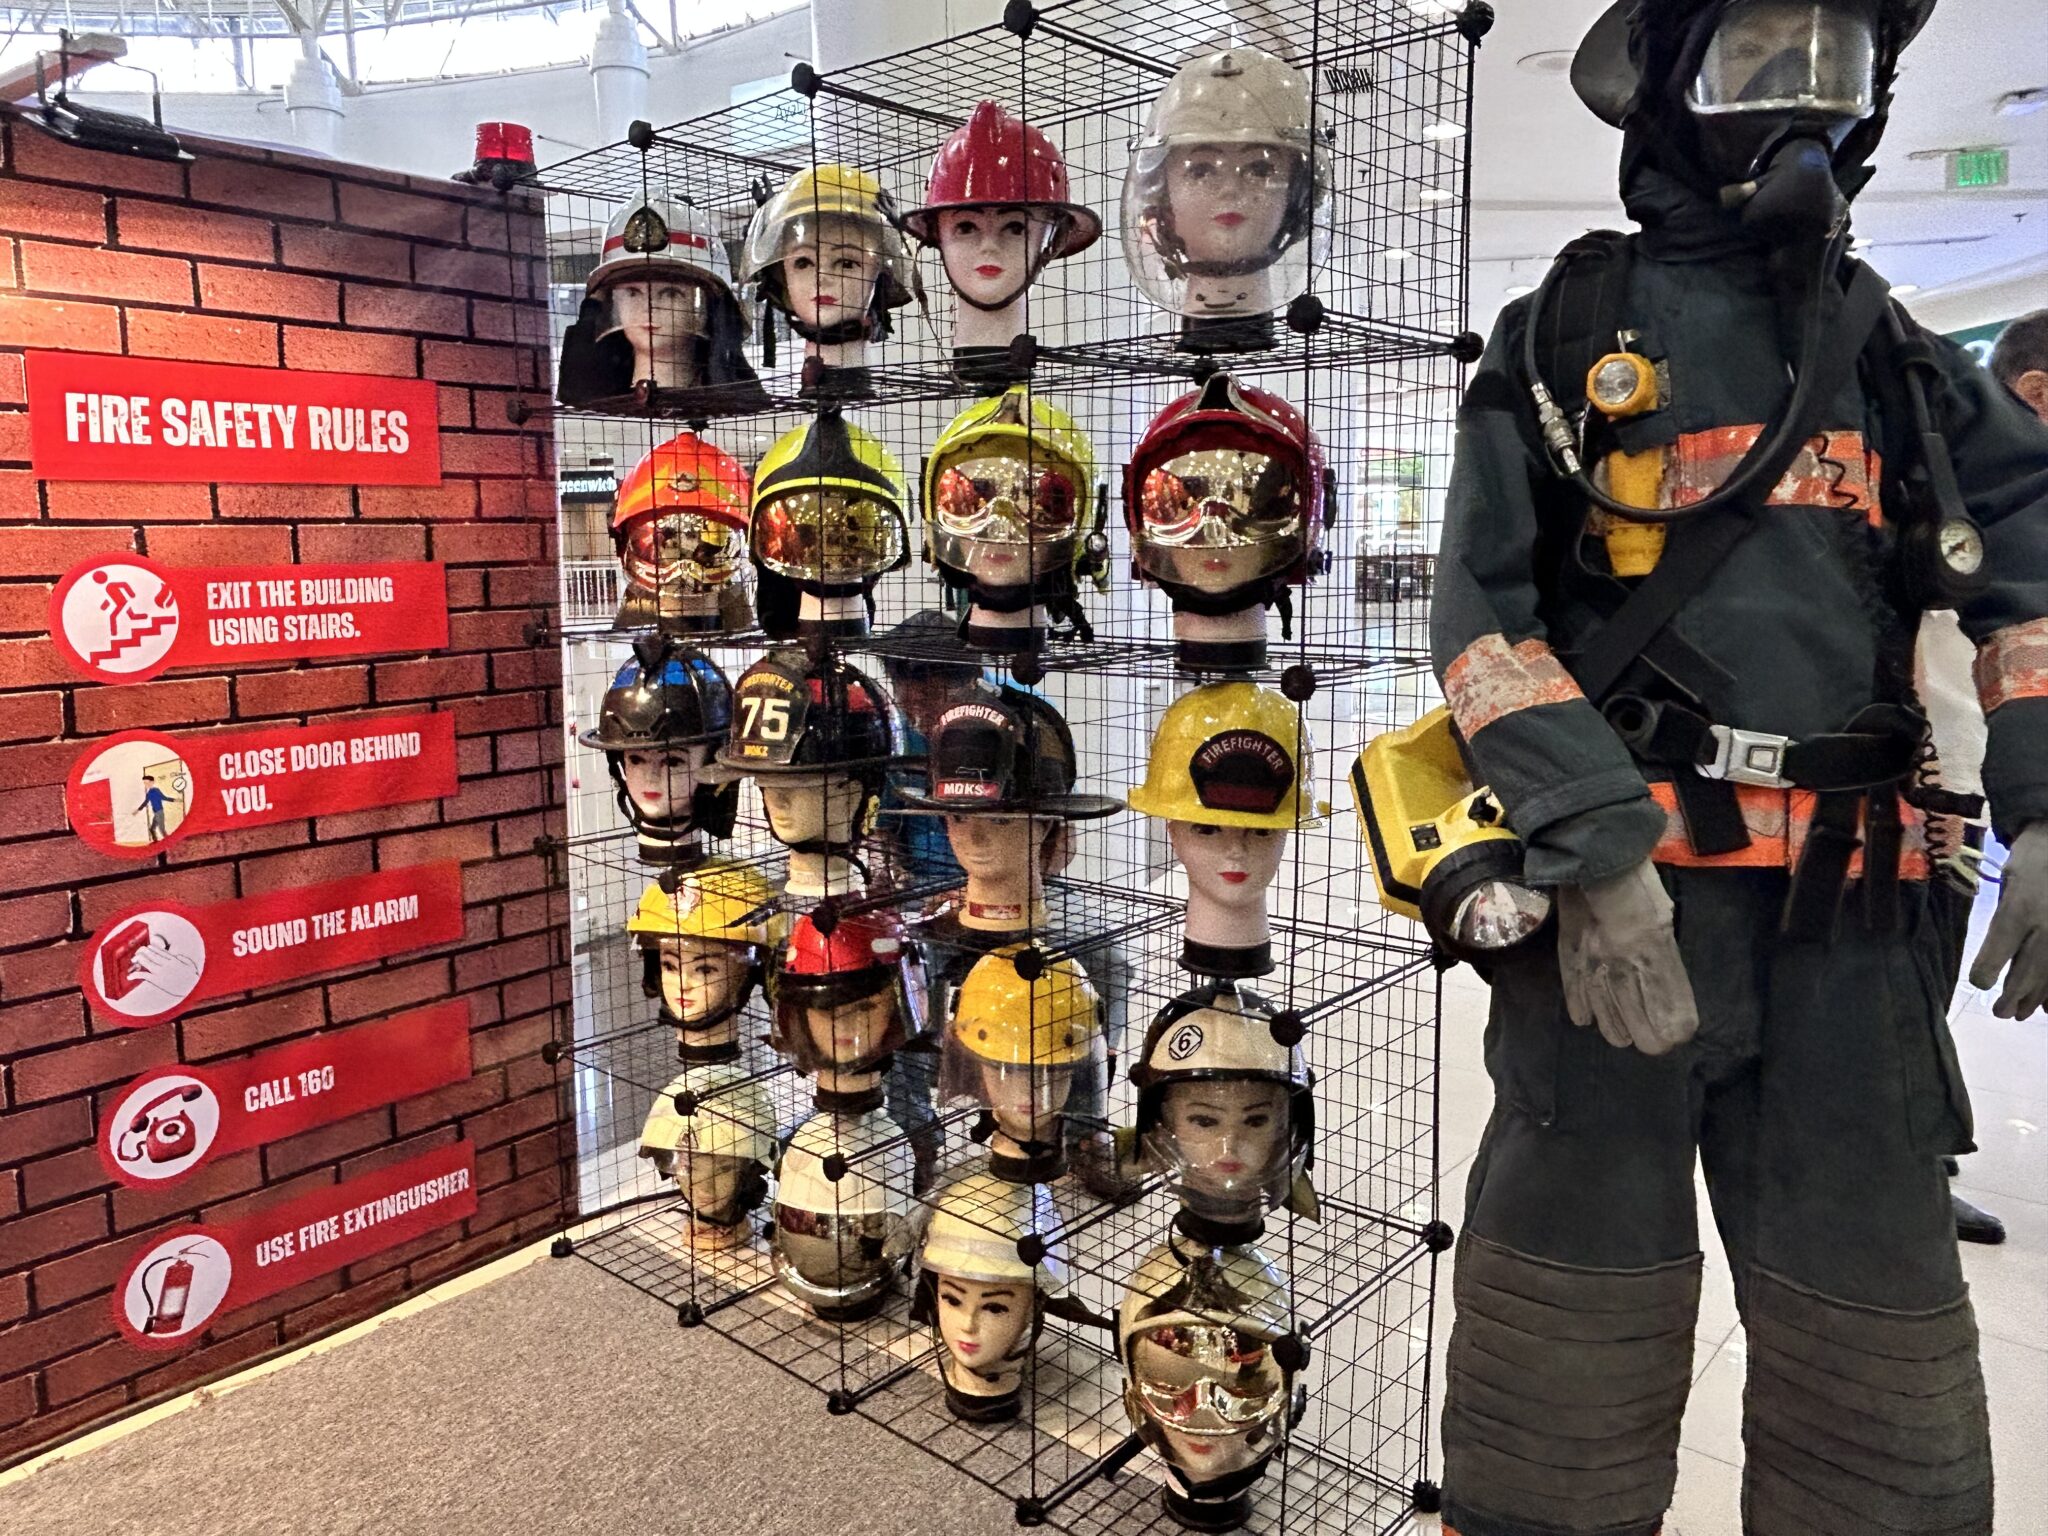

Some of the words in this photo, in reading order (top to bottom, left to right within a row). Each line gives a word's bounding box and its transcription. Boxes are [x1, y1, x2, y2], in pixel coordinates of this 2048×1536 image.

[65, 392, 152, 445] FIRE
[161, 397, 297, 449] SAFETY
[307, 405, 410, 454] RULES
[206, 581, 252, 610] EXIT
[256, 580, 296, 608] THE
[300, 576, 394, 606] BUILDING
[208, 616, 279, 647] USING
[283, 612, 361, 642] STAIRS.
[741, 697, 790, 741] 75
[940, 704, 1005, 726] FIREFIGHTER
[219, 747, 286, 781] CLOSE
[290, 740, 347, 772] DOOR
[350, 732, 421, 764] BEHIND
[1202, 737, 1284, 770] FIREFIGHTER
[221, 785, 273, 816] YOU.
[232, 918, 307, 957] SOUND
[311, 909, 347, 940] THE
[350, 895, 418, 932] ALARM
[1179, 1032, 1192, 1052] 6
[244, 1076, 296, 1112] CALL
[298, 1065, 335, 1097] 160
[256, 1231, 295, 1267] USE
[299, 1215, 340, 1252] FIRE
[343, 1168, 470, 1235] EXTINGUISHER
